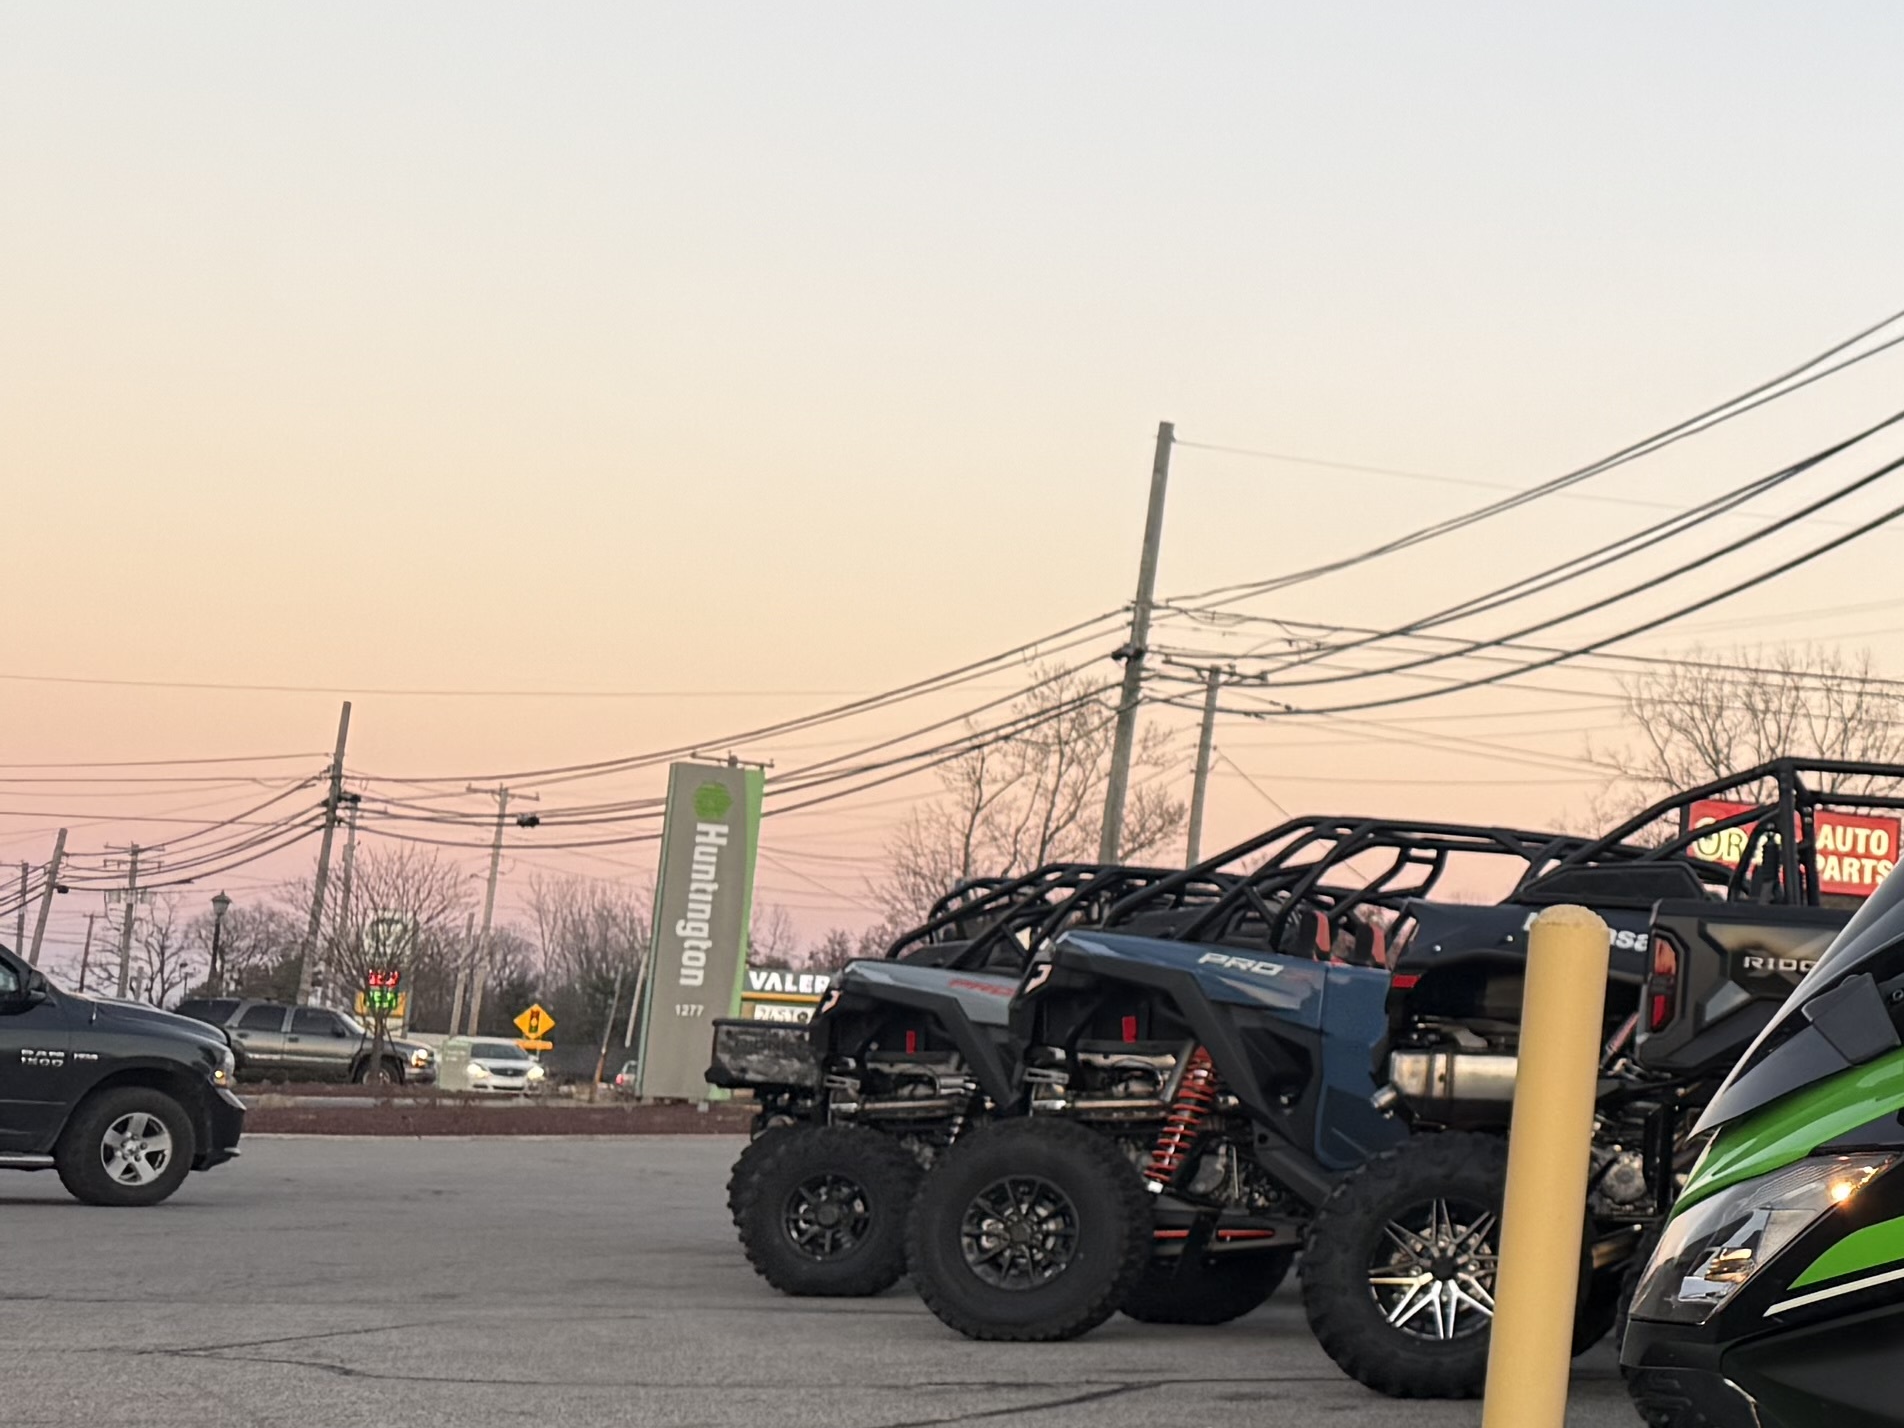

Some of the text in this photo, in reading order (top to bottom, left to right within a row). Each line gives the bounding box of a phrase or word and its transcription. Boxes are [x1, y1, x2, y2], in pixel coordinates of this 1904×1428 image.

[1815, 823, 1890, 856] AUTO
[675, 821, 730, 987] Huntington
[1198, 952, 1285, 976] PRO
[674, 1004, 704, 1018] 1277
